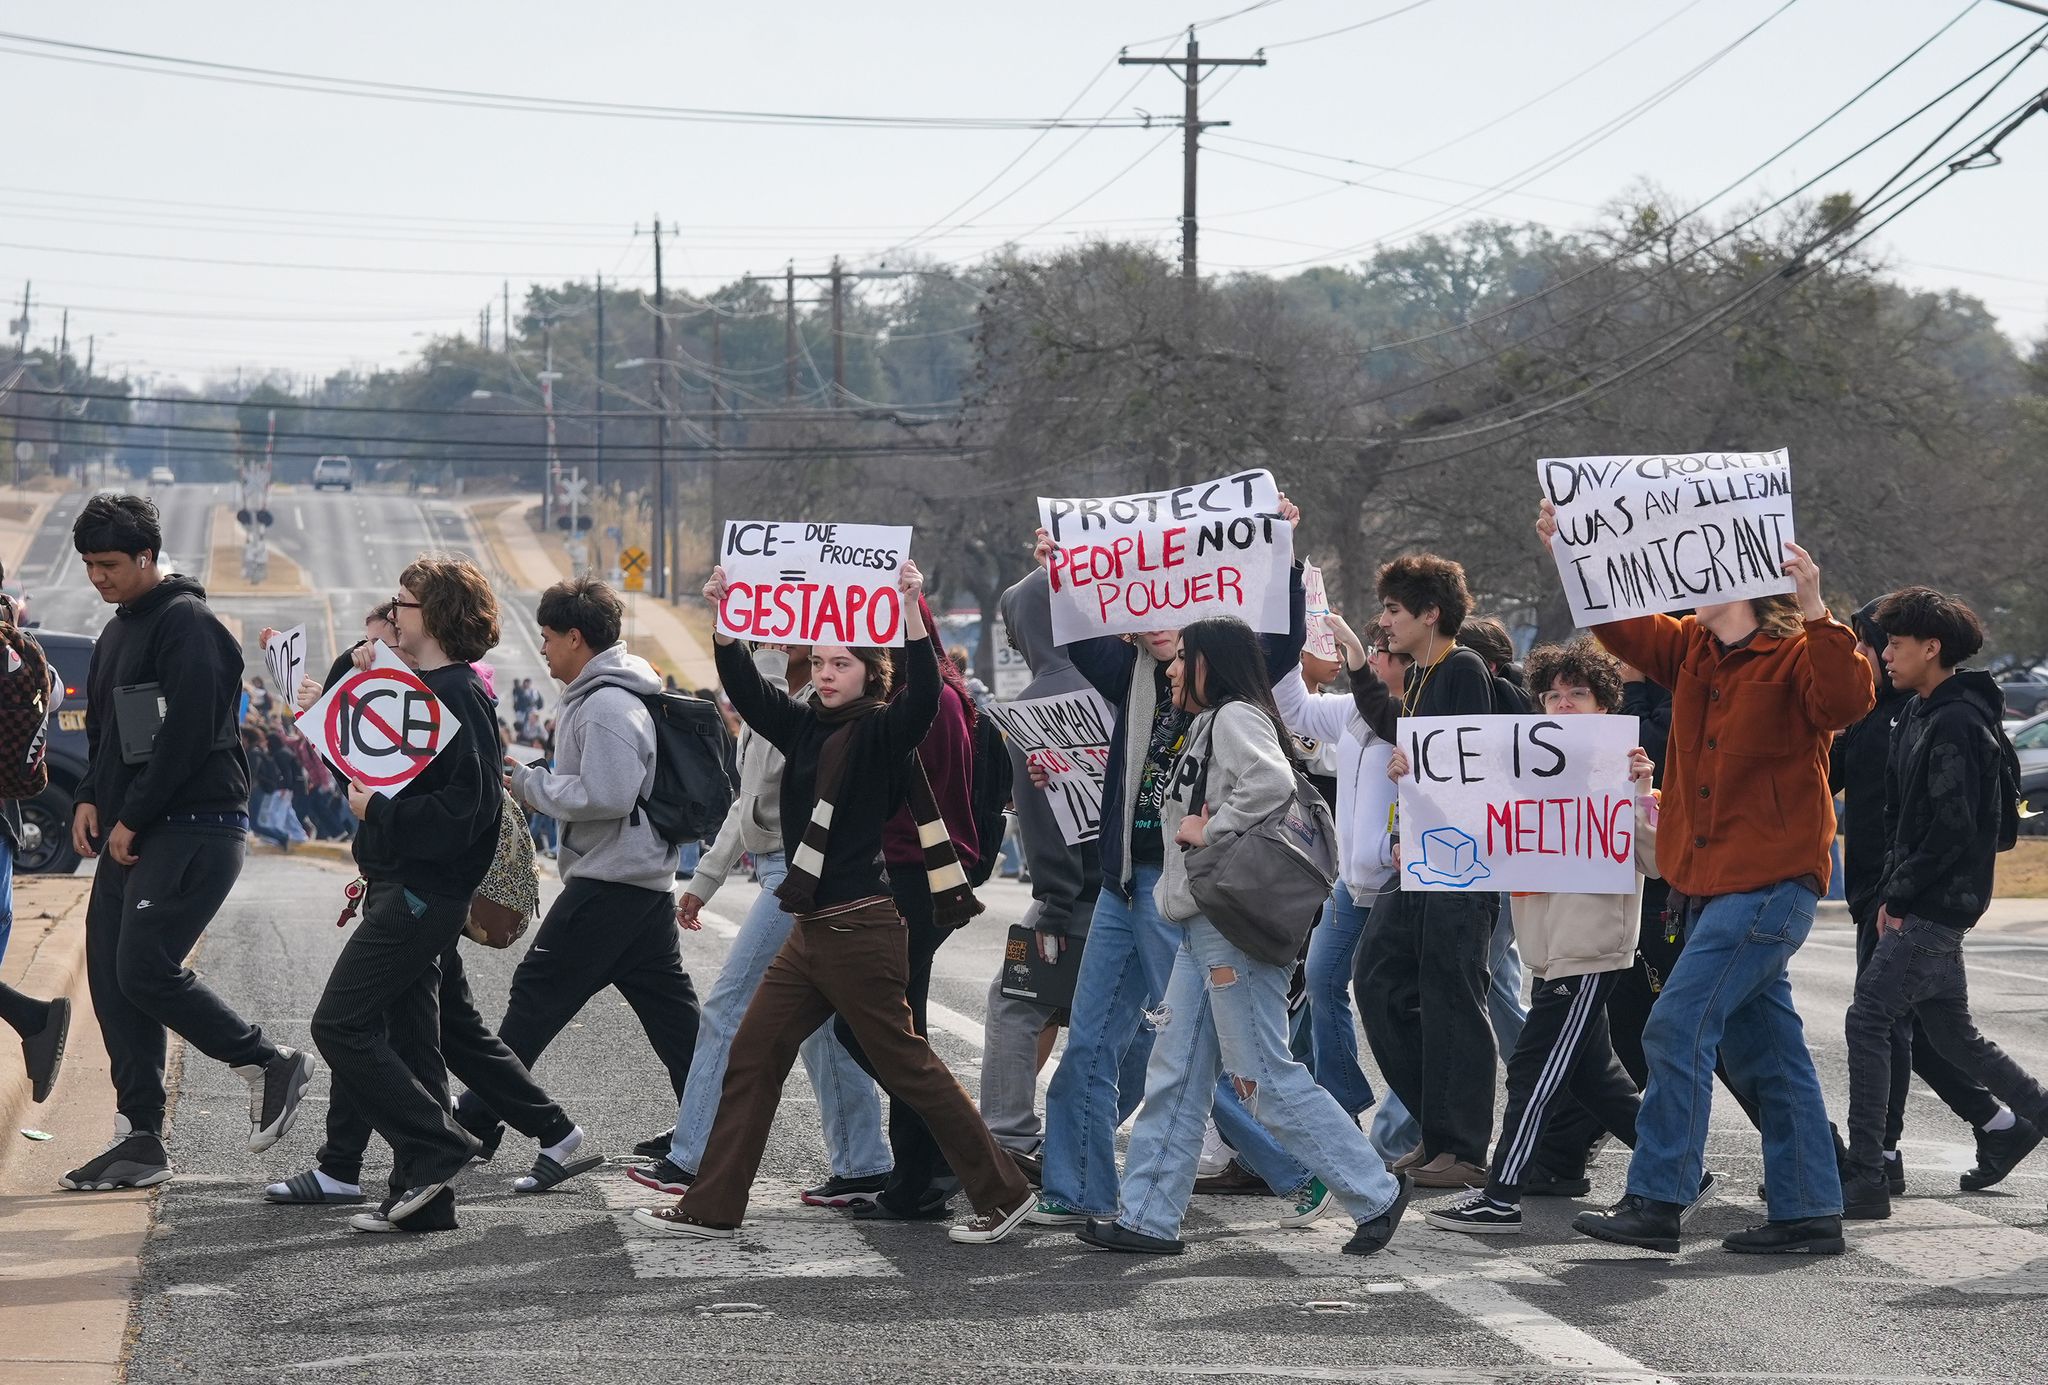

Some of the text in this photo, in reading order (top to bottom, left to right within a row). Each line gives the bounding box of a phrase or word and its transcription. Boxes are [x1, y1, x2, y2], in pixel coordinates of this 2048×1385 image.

[1050, 472, 1264, 542] PROTECT
[1546, 450, 1783, 506] DAVY CROCKETT
[805, 523, 838, 543] DUE
[1557, 496, 1634, 546] WAS
[1646, 488, 1680, 520] AN
[820, 544, 898, 571] PROCESS
[1050, 513, 1283, 593] PEOPLE NOT
[1570, 513, 1787, 610] IMMIGRANT
[719, 581, 900, 644] GESTAPO
[1097, 566, 1243, 623] POWER
[340, 688, 439, 757] ICE
[988, 695, 1110, 749] NO HUMAN
[1066, 751, 1095, 773] IS
[1412, 721, 1566, 784] ICE IS
[1487, 794, 1632, 863] MELTING
